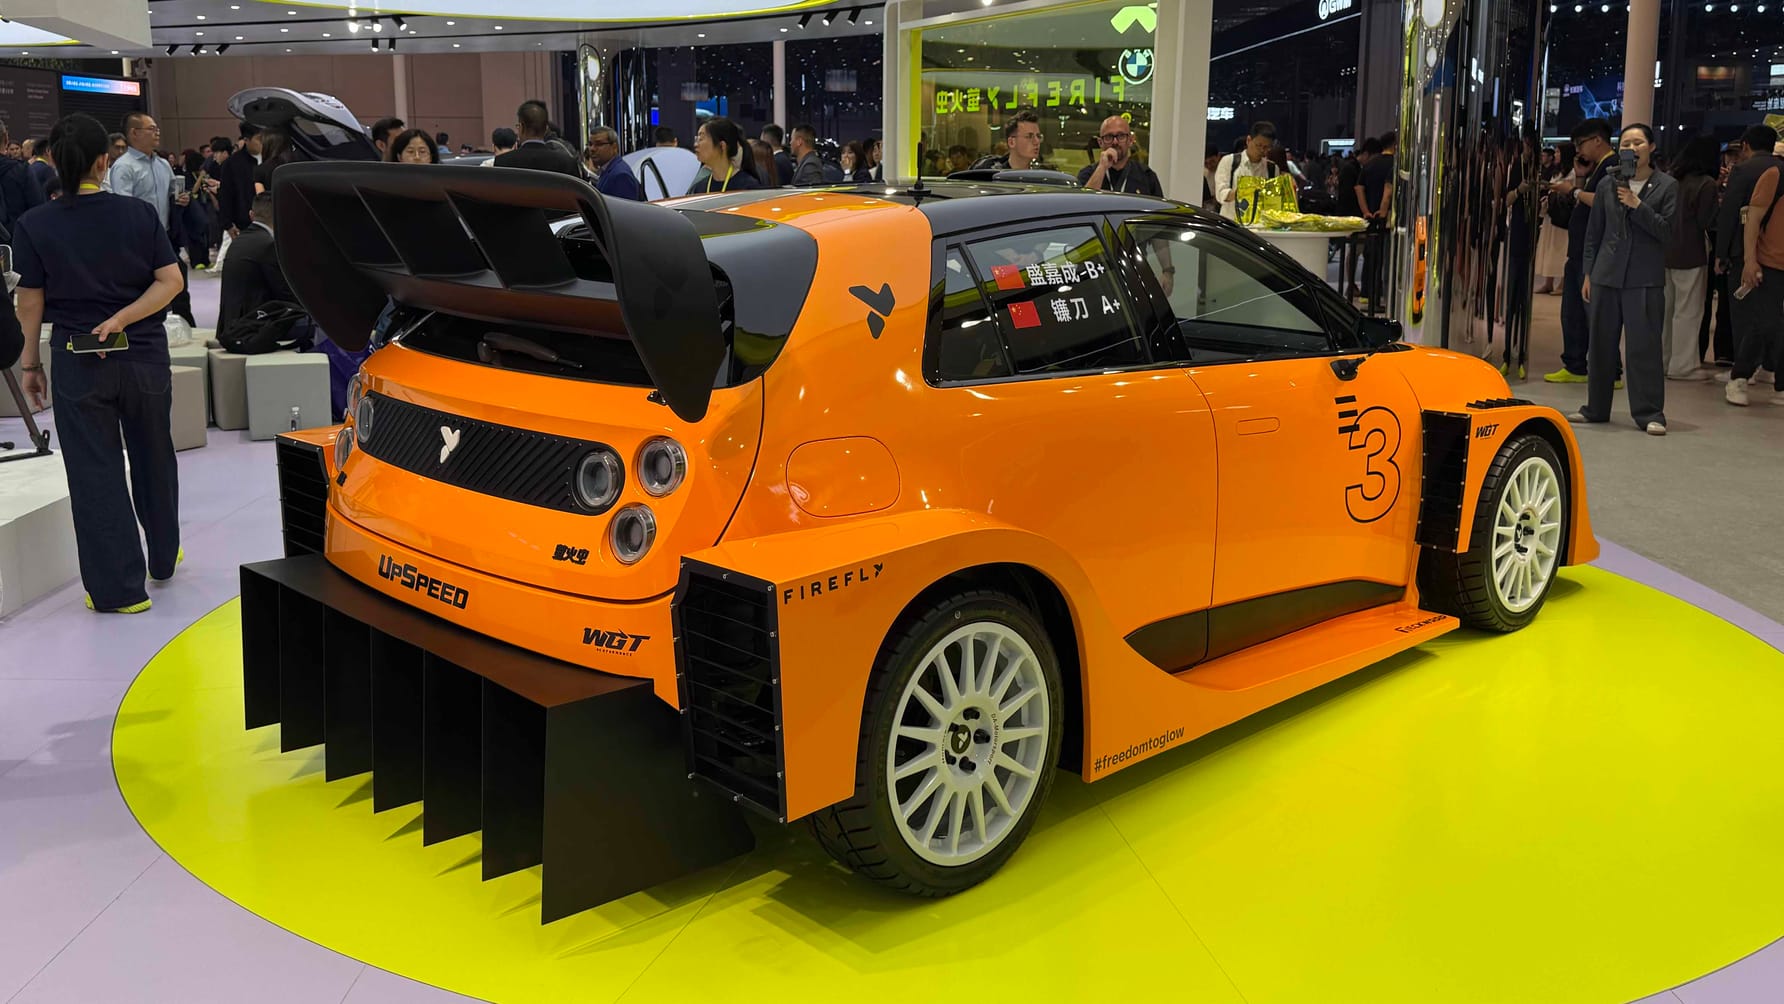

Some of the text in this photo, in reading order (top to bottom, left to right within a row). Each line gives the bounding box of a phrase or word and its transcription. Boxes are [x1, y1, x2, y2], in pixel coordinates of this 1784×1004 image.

[1101, 295, 1121, 315] A+
[1345, 405, 1402, 524] 3
[783, 562, 884, 605] FIREFLY
[582, 626, 651, 652] WGT
[1094, 726, 1185, 773] #freedomtoglow
